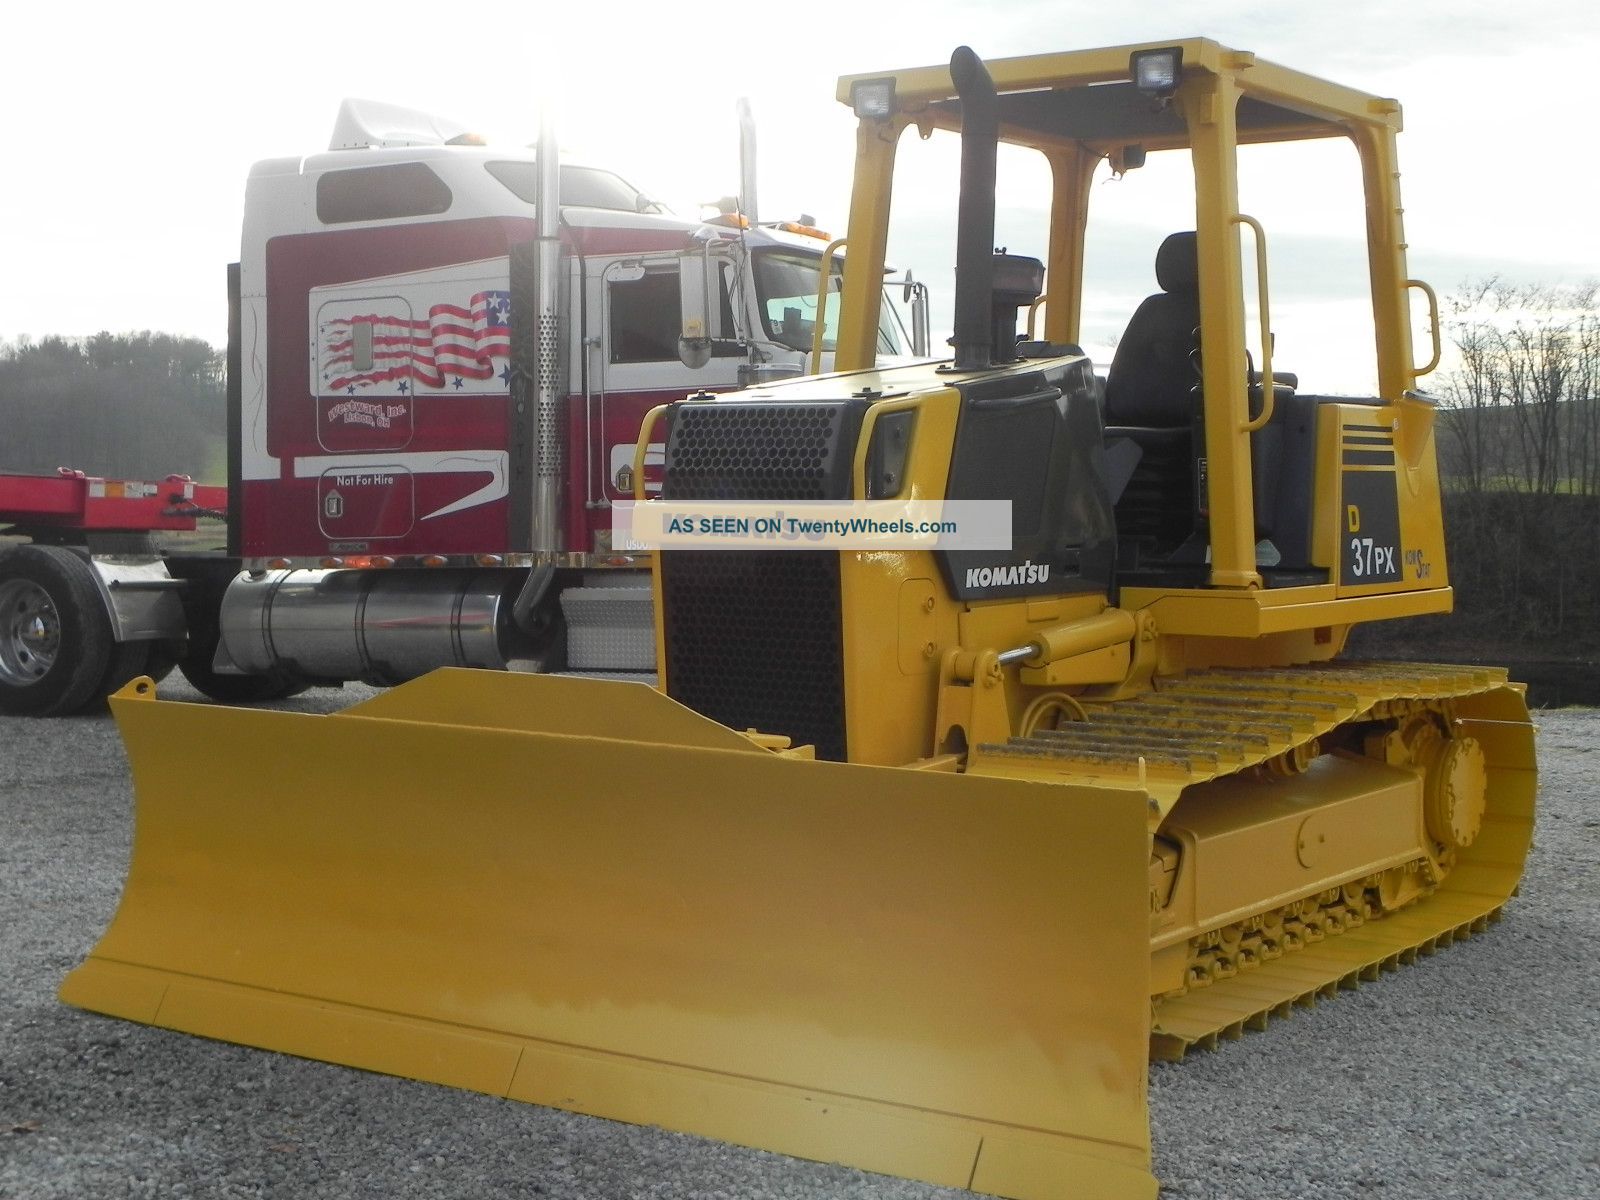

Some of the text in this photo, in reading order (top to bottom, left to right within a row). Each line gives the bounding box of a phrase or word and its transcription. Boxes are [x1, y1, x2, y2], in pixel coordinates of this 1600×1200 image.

[336, 474, 393, 486] Not For Hire
[1347, 504, 1360, 532] D
[965, 560, 1049, 588] KOMATSU
